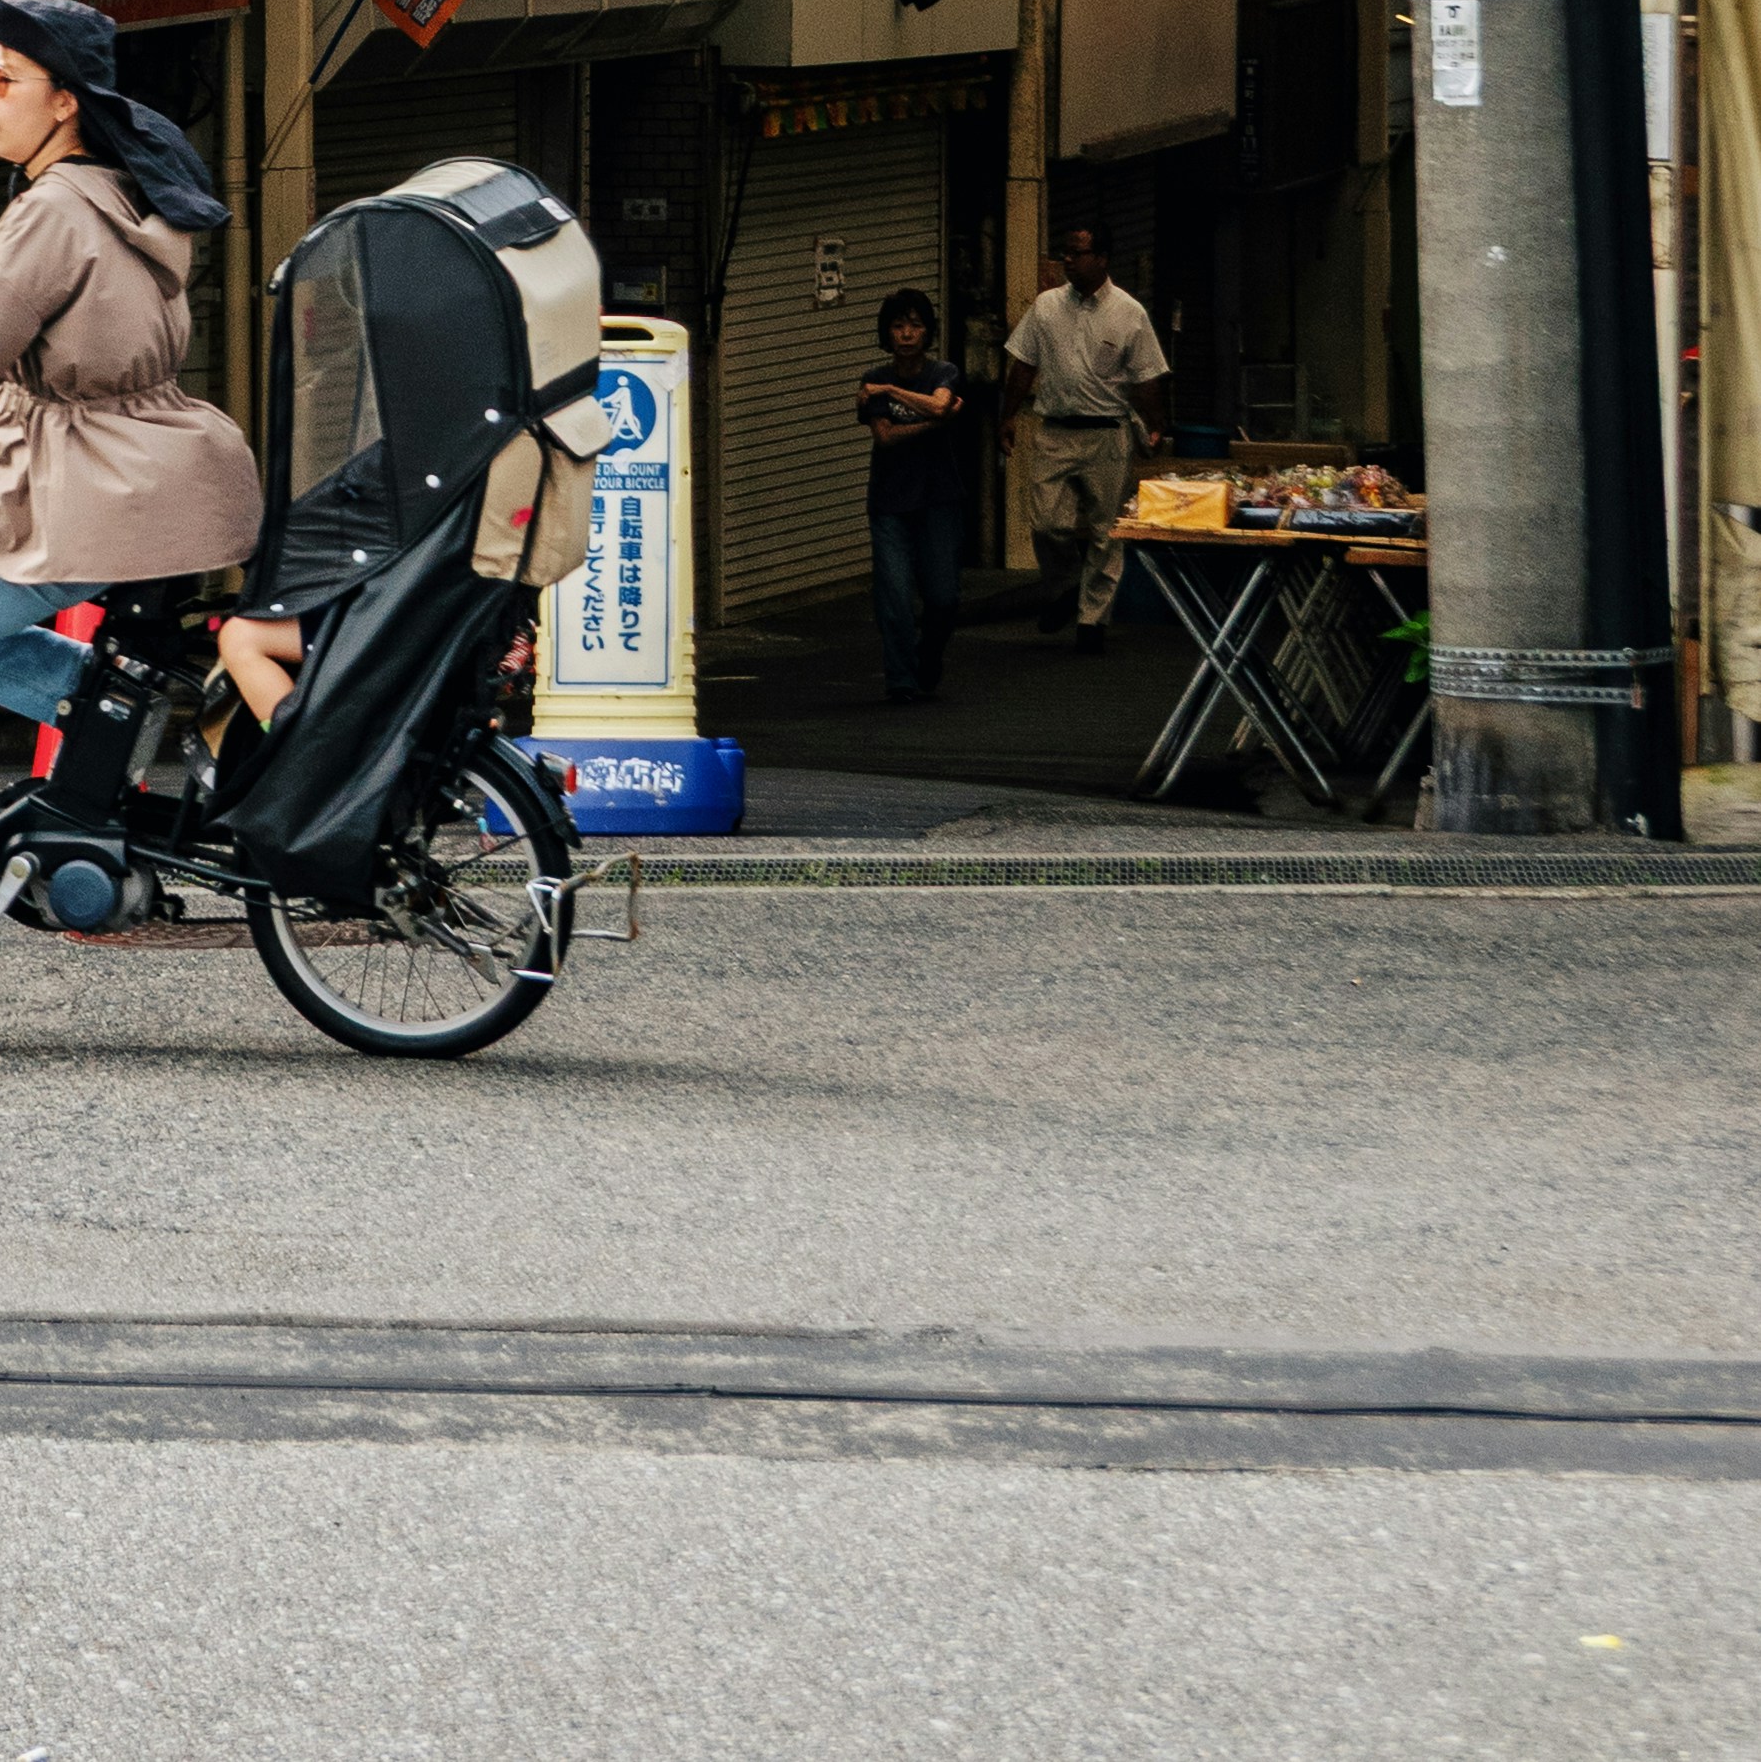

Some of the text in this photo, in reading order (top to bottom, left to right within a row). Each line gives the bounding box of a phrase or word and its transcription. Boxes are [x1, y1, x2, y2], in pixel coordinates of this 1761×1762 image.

[603, 463, 660, 476] DIOUNT
[593, 477, 665, 489] YOUR BICYCLE
[617, 495, 643, 652] 自転車は降りて
